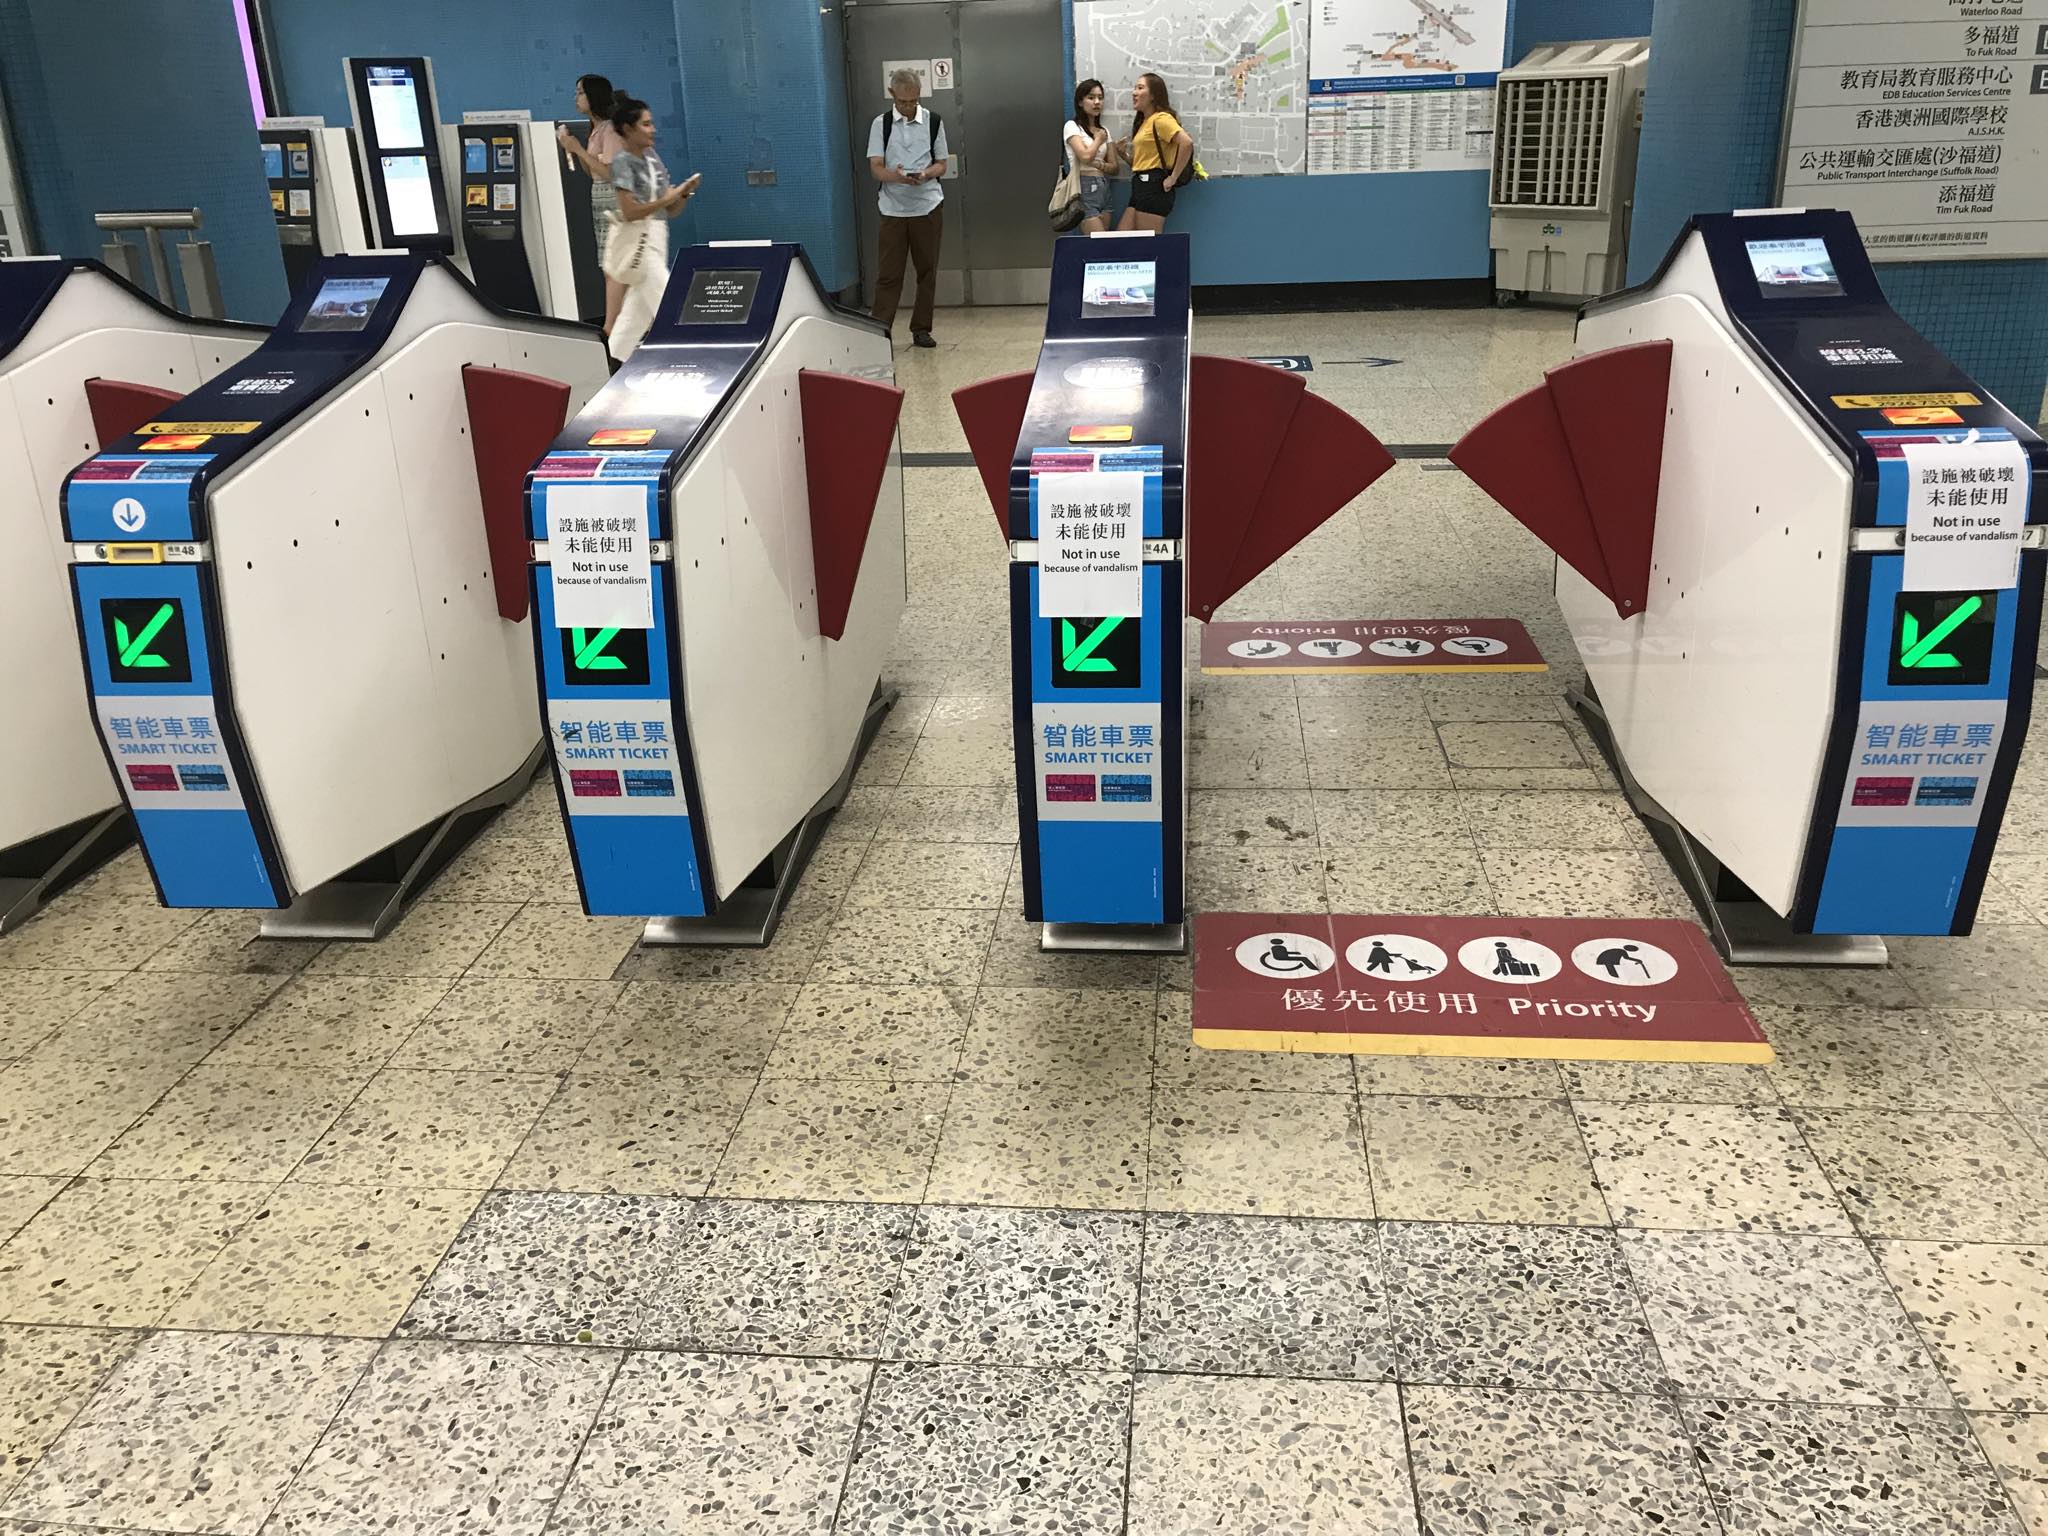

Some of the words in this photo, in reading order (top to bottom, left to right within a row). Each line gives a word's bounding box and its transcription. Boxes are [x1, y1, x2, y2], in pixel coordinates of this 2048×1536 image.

[1960, 7, 1999, 16] Waterloo
[2000, 7, 2023, 15] Road
[1963, 25, 2020, 45] 多福道
[1967, 48, 1976, 56] To
[1978, 48, 1993, 56] Fuk
[1995, 47, 2017, 55] Road
[1840, 65, 2013, 90] 教育局教育服務中心
[1882, 90, 1900, 99] EDB
[1902, 89, 1945, 98] Education
[1947, 88, 1981, 97] Services
[1983, 87, 2011, 96] Centre
[1855, 105, 2008, 129] 香港澳洲國際學校
[1817, 171, 1843, 181] Public
[1845, 170, 1886, 180] Transport
[1887, 168, 1939, 179] Interchange
[1940, 166, 1973, 177] (Suffolk
[1974, 165, 1999, 176] Road)
[1938, 184, 1996, 203] 添福道
[1936, 206, 1952, 214] Tim
[1954, 205, 1969, 214] Fuk
[1971, 204, 1993, 213] Road
[1922, 467, 2015, 485] 設施被破壞
[1927, 487, 2008, 507] 未能使用
[1050, 503, 1131, 519] 設施被破壞
[559, 517, 636, 533] 設施被破壞
[1933, 516, 1958, 527] Not
[1962, 516, 1975, 527] in
[1978, 517, 2001, 526] use
[1056, 523, 1126, 540] 未能使用
[1911, 533, 1954, 542] because
[1957, 532, 1968, 541] of
[1968, 531, 2018, 541] vandalism
[182, 546, 195, 555] 48
[565, 537, 632, 553] 未能使用
[1153, 544, 1169, 554] 4A
[1062, 549, 1083, 559] Not
[1086, 549, 1097, 559] in
[1100, 551, 1120, 559] use
[572, 562, 593, 572] Not
[595, 562, 606, 571] in
[1044, 564, 1080, 573] because
[1082, 564, 1091, 572] of
[1093, 564, 1138, 572] vandalism
[557, 577, 591, 585] because
[592, 577, 602, 585] of
[603, 577, 647, 585] vandalism
[1251, 626, 1335, 634] Priority
[110, 716, 215, 739] 智能車票
[559, 720, 669, 744] 智能車票
[1043, 723, 1154, 748] 智能車票
[1866, 723, 1995, 749] 智能車票
[118, 743, 166, 754] SMART
[169, 743, 217, 754] TICKET
[566, 748, 615, 759] SMART
[618, 748, 669, 759] TICKET
[1045, 752, 1097, 764] SMART
[1101, 752, 1153, 764] TICKET
[1861, 753, 1923, 765] SMART
[1926, 753, 1987, 765] TICKET
[1280, 988, 1478, 1015] 優先使用
[1508, 998, 1657, 1023] Priority
